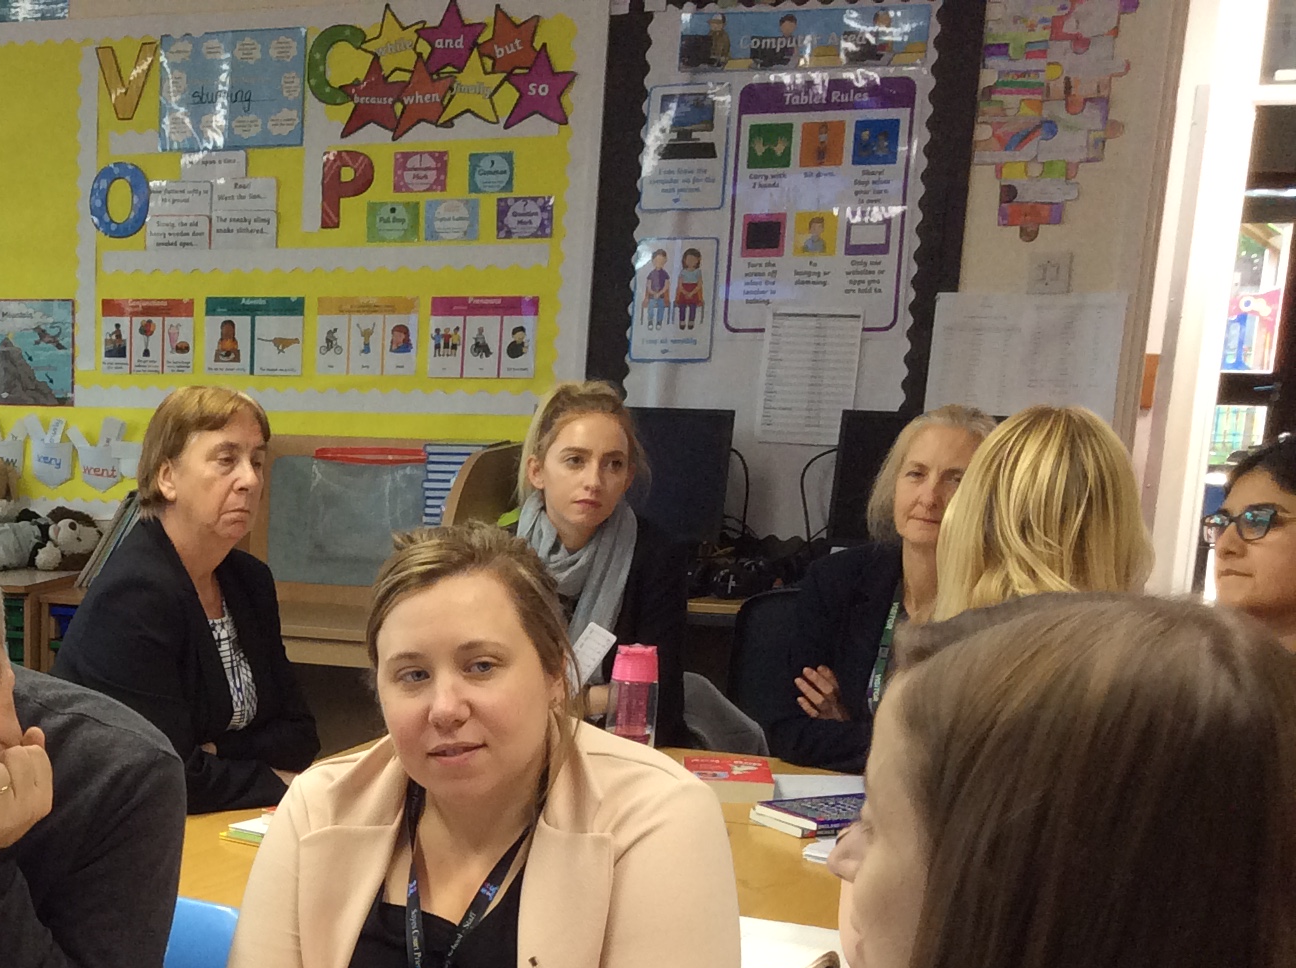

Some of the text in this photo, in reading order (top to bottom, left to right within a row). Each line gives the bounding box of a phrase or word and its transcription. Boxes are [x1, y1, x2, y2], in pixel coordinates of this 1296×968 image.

[375, 38, 414, 57] while
[435, 35, 464, 50] and
[495, 39, 523, 59] but
[740, 33, 818, 50] Computer
[308, 24, 366, 105] C
[95, 41, 158, 121] V
[452, 82, 492, 99] finally
[528, 83, 549, 96] so
[192, 87, 252, 112] stuing
[354, 93, 394, 105] because
[403, 92, 441, 105] when
[784, 90, 869, 106] Tablet Rules
[321, 150, 375, 229] P
[229, 215, 252, 225] sneaky
[512, 211, 538, 219] Question
[517, 218, 533, 226] Mark
[168, 229, 190, 238] wooden
[2, 311, 33, 319] Mountain
[37, 453, 62, 469] very
[82, 465, 118, 478] went
[885, 602, 900, 630] VISITOR
[872, 674, 882, 702] VISITOR
